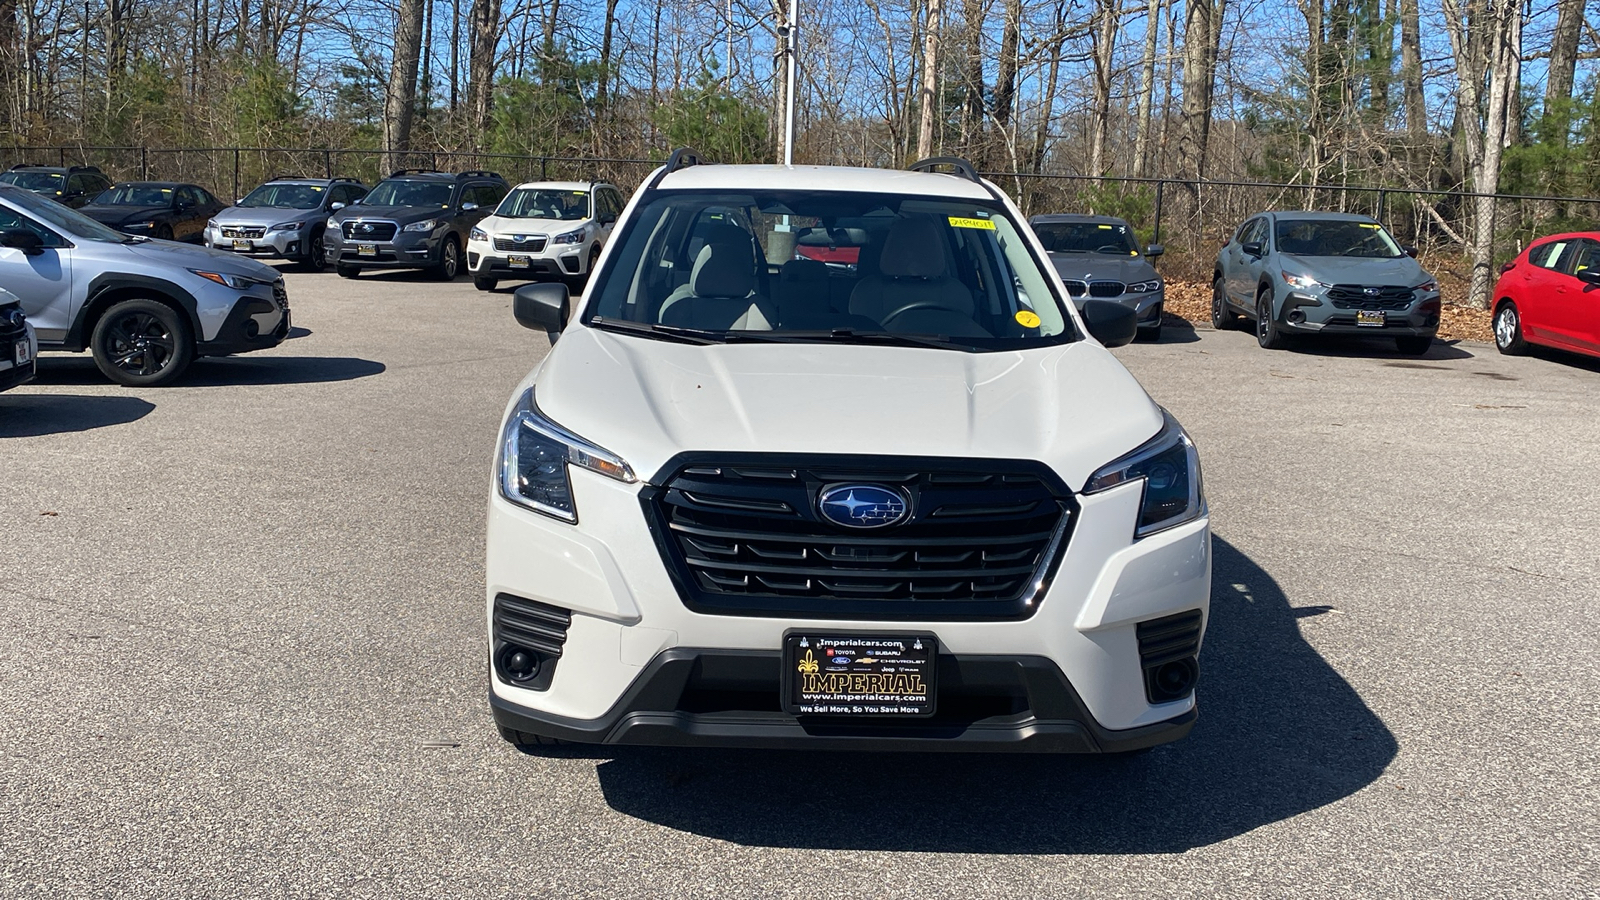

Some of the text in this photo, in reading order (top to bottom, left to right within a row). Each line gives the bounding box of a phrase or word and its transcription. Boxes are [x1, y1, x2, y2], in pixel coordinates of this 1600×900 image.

[820, 638, 902, 647] Imperialcars.com
[803, 672, 926, 694] IMPERIAL
[802, 693, 926, 702] www.imperialcars.com
[829, 706, 851, 714] More,
